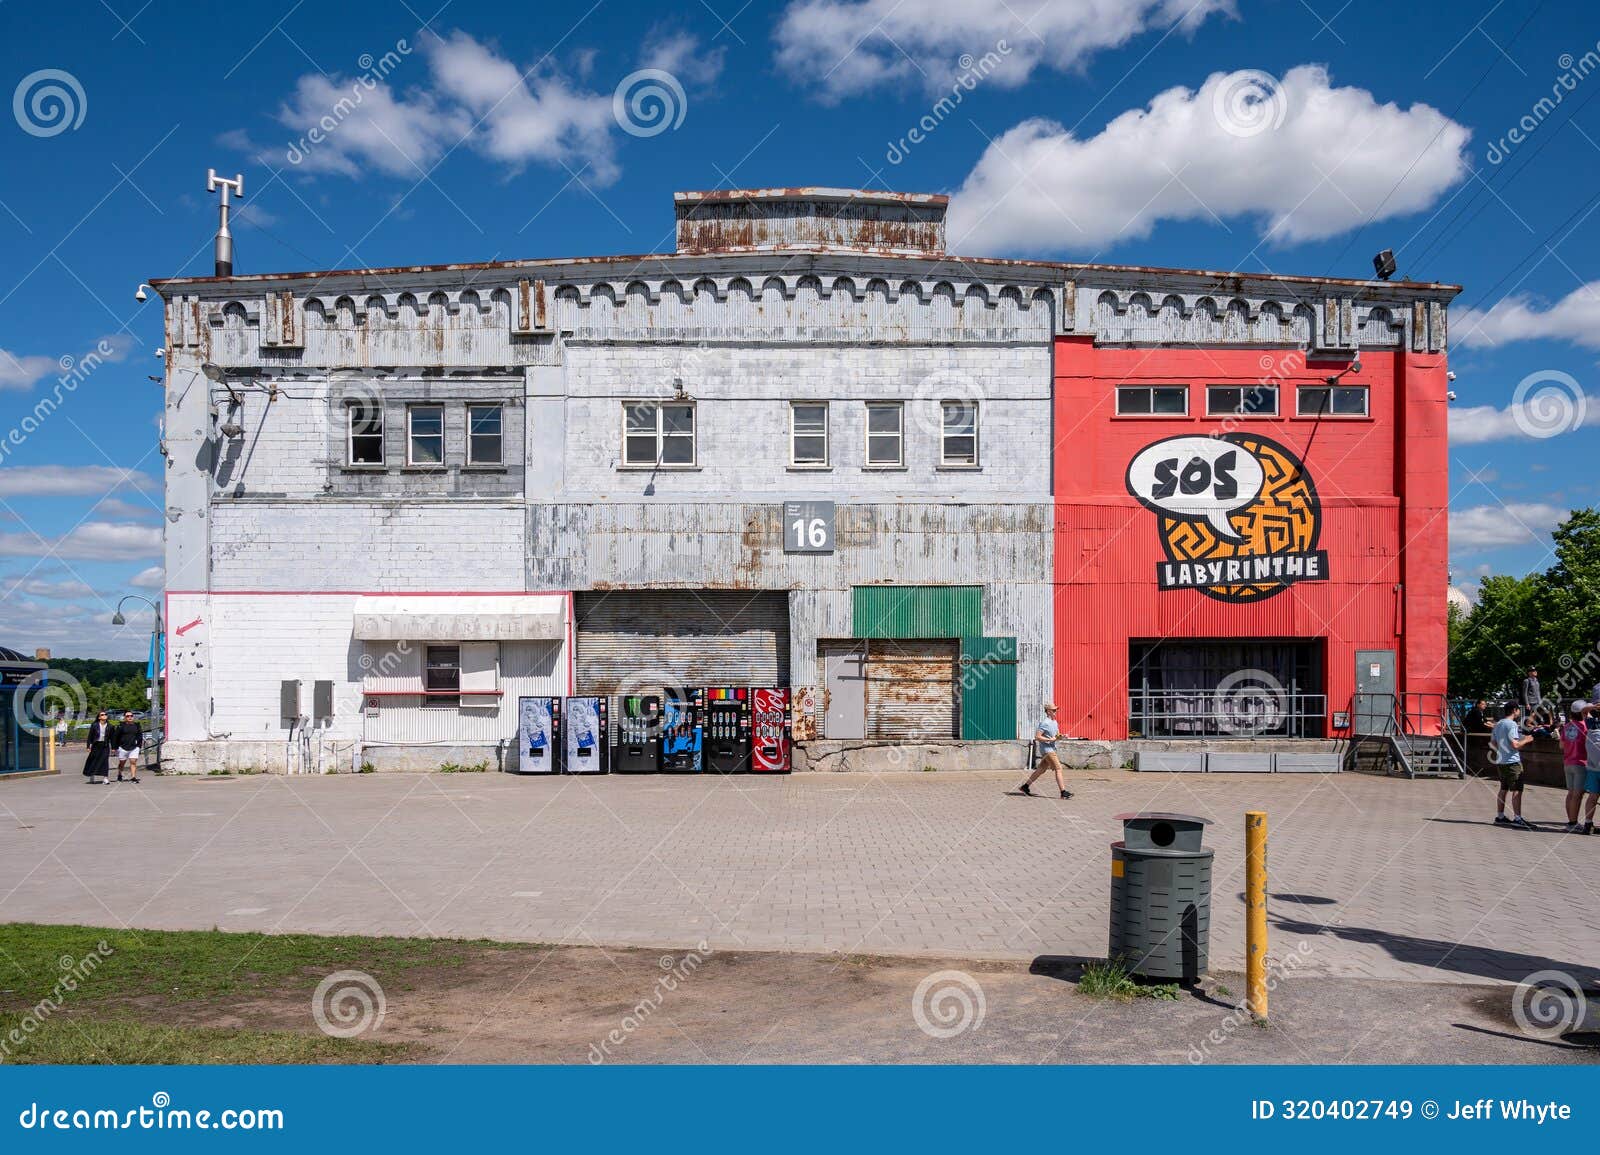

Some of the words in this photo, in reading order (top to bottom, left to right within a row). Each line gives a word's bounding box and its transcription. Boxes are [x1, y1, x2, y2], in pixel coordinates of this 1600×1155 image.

[1151, 450, 1238, 500] SOS
[792, 518, 826, 548] 16
[1165, 556, 1319, 586] LABYRINTHE
